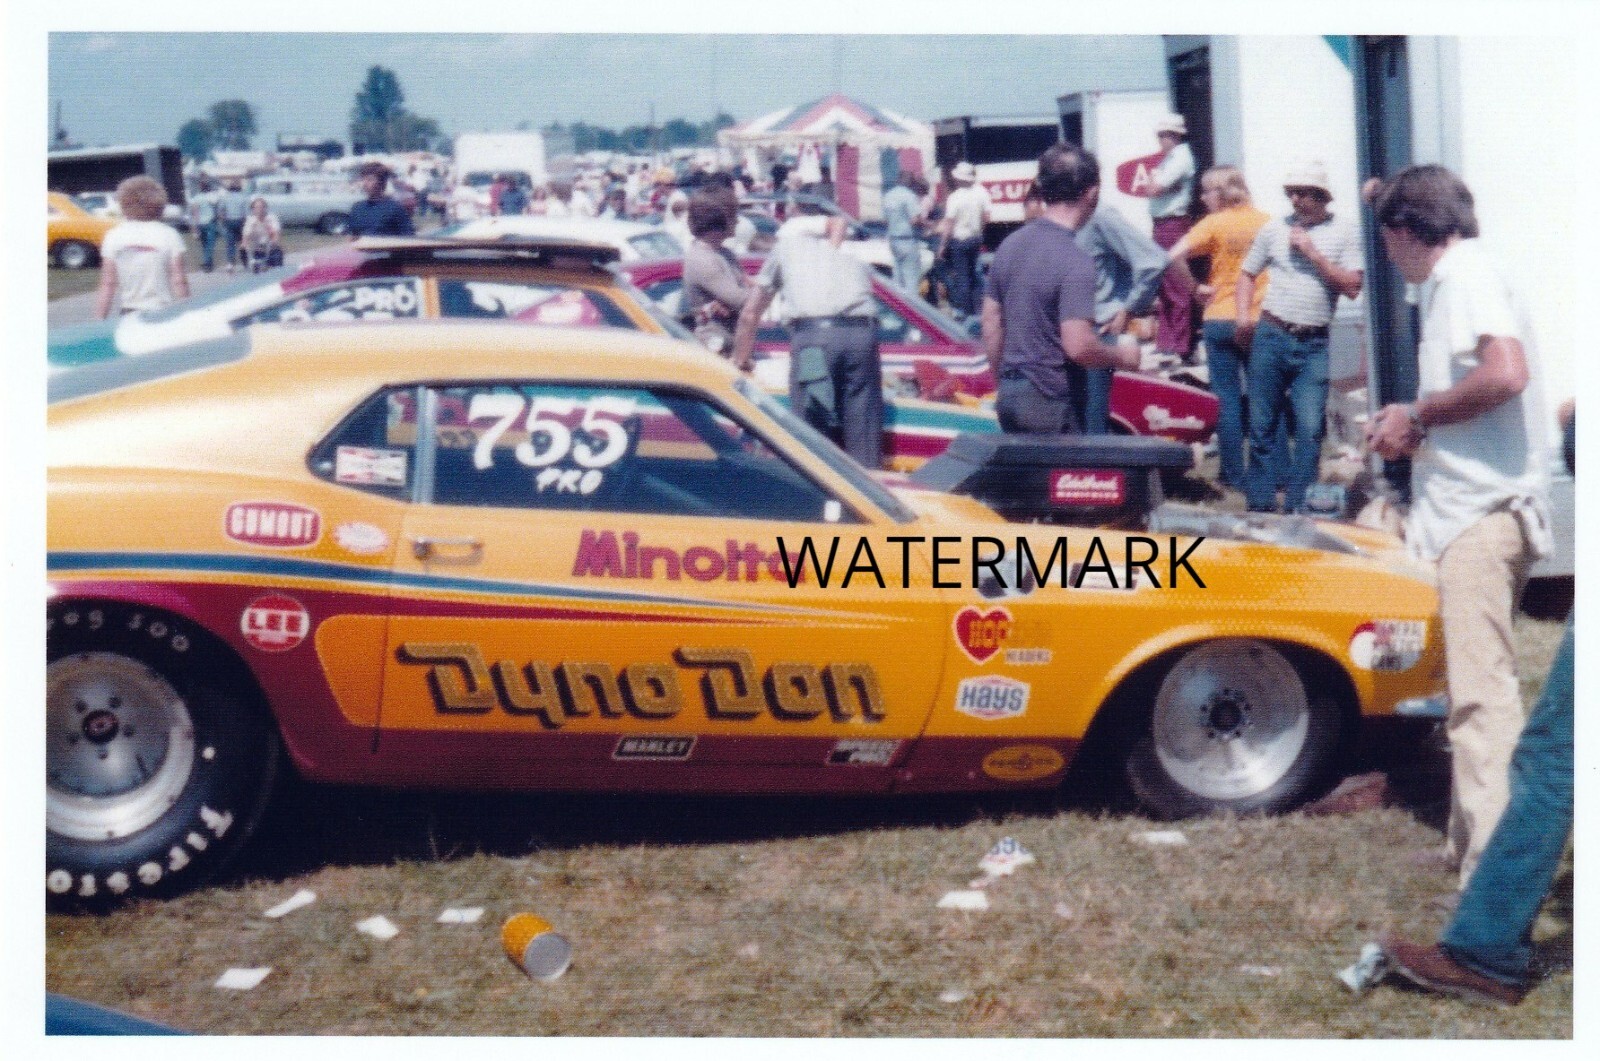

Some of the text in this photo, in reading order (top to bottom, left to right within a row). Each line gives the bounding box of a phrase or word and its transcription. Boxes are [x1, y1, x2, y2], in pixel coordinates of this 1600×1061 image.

[467, 393, 637, 470] 755
[231, 506, 313, 541] GUMOUT
[395, 642, 887, 729] Dyno Don
